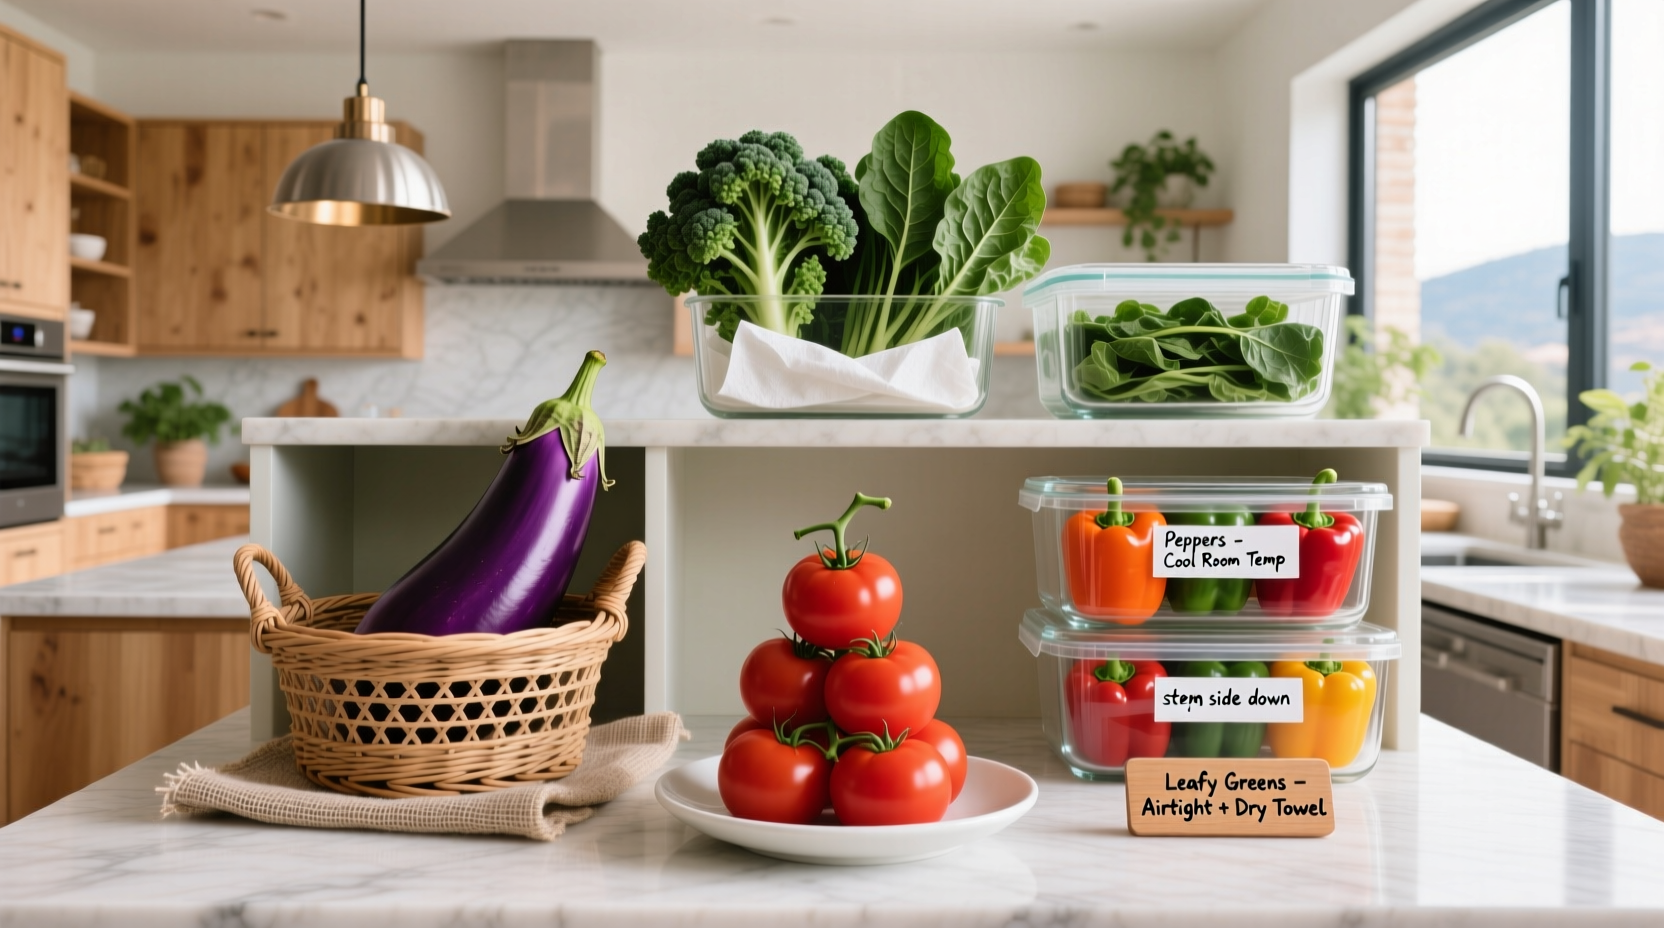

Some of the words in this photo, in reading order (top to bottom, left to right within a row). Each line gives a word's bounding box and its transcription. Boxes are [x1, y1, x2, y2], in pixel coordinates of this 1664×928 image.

[1165, 530, 1226, 553] Peppers
[1163, 552, 1196, 568] Cool
[1202, 552, 1240, 568] Room
[1246, 550, 1286, 573] Temp
[1209, 687, 1242, 706] side
[1248, 687, 1291, 706] down
[1165, 771, 1218, 798] Leafy
[1224, 771, 1287, 791] Greens
[1141, 797, 1213, 822] Airtight
[1218, 801, 1230, 815] +
[1235, 797, 1267, 823] Dry
[1271, 797, 1328, 817] Towel
